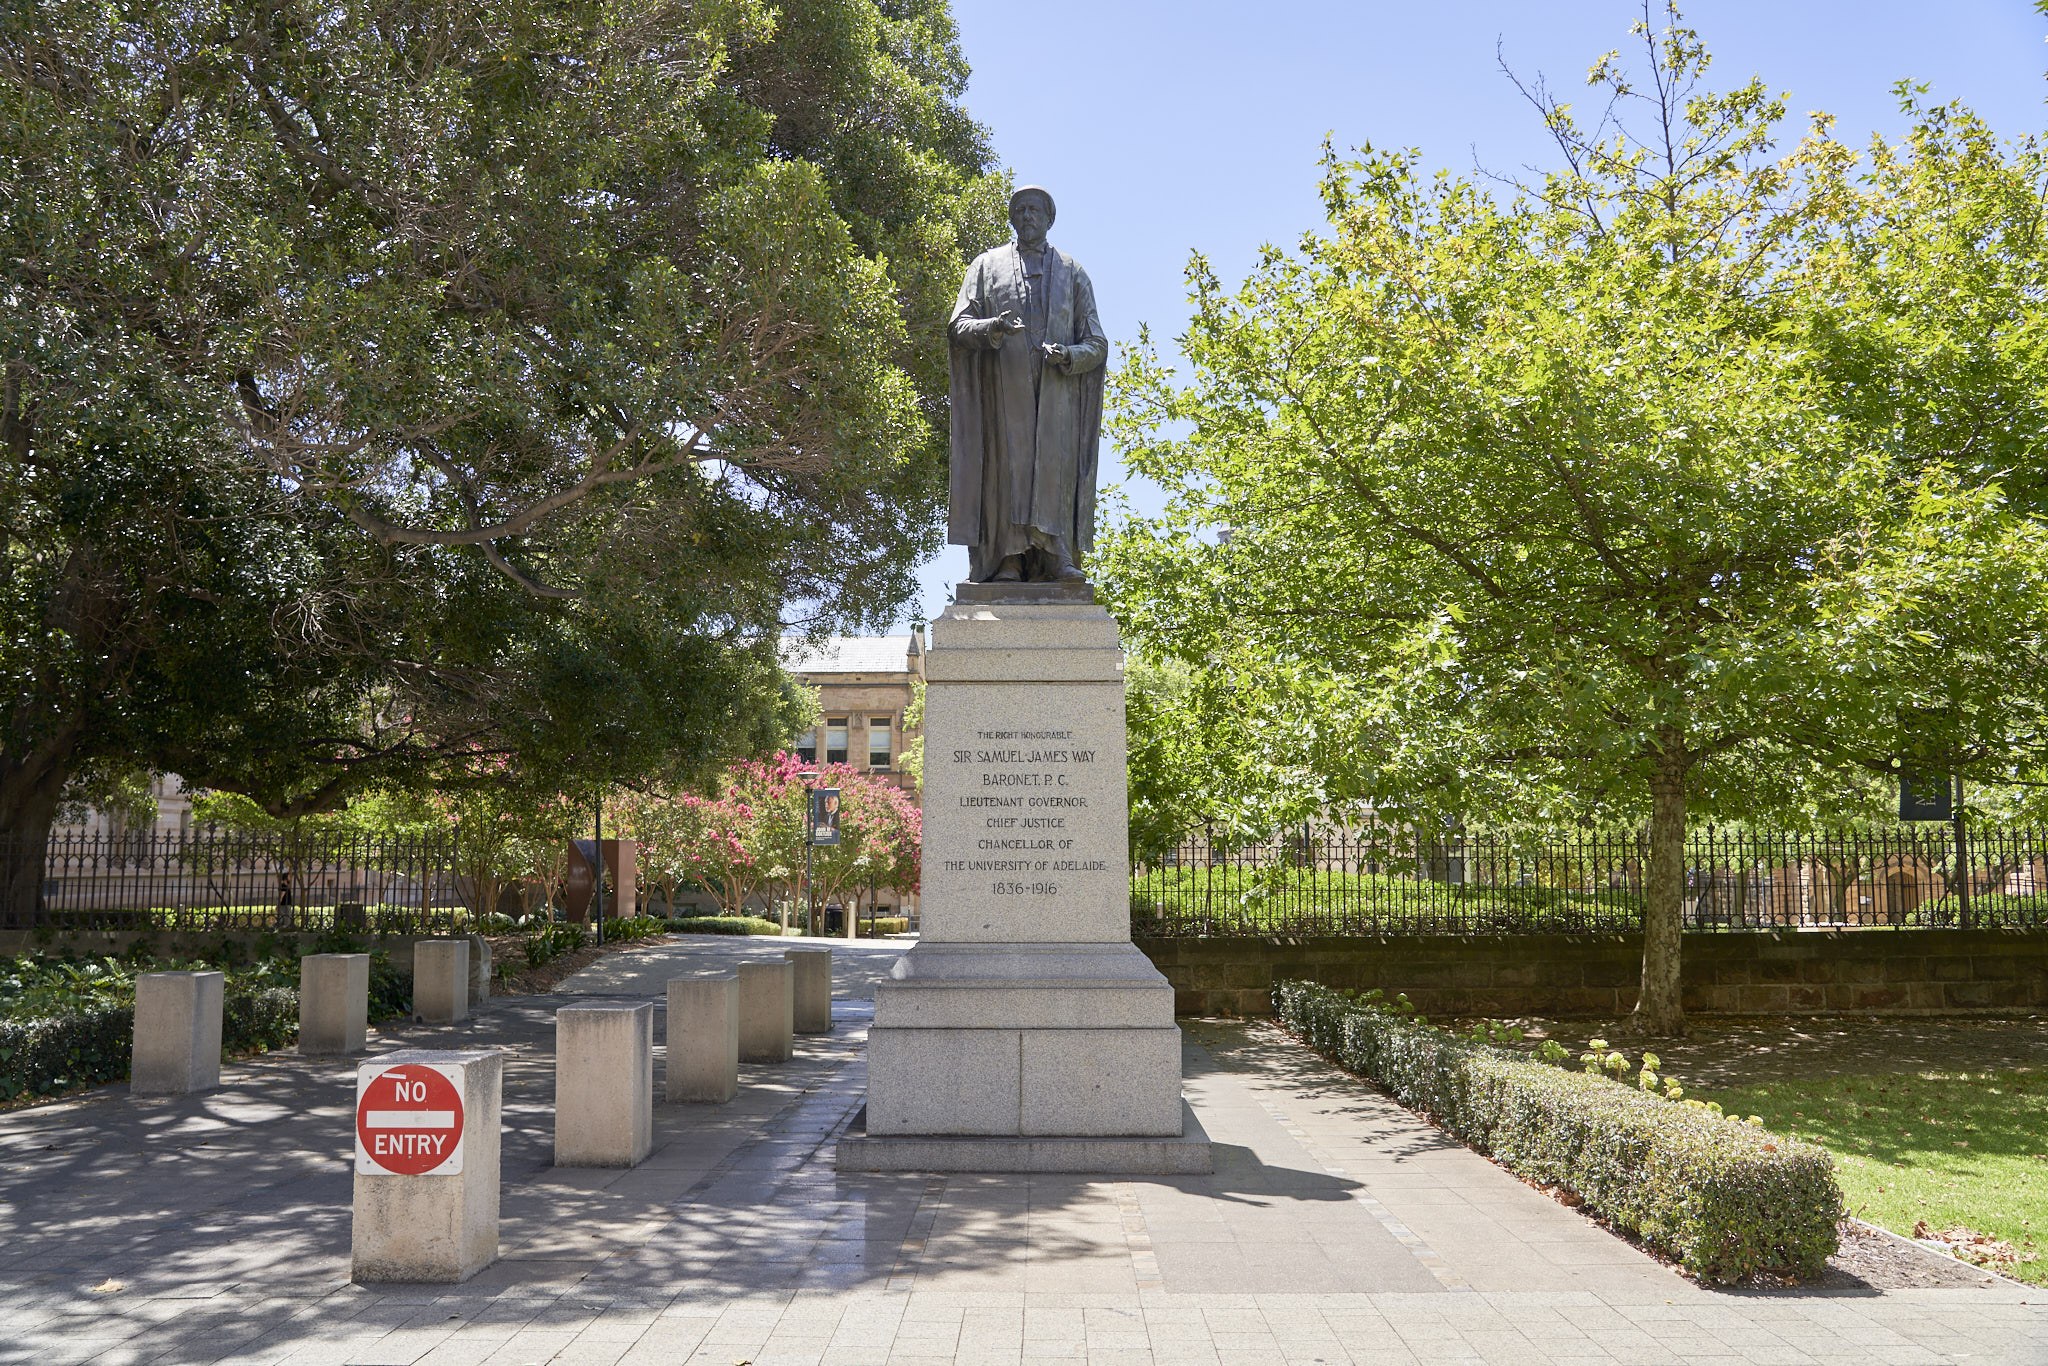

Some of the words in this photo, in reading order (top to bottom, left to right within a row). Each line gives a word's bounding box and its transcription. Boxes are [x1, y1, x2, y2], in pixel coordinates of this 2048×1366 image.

[977, 731, 994, 740] THE
[995, 731, 1018, 740] RIGHT
[1021, 731, 1073, 740] HONOURABLE
[953, 750, 972, 763] SIR
[977, 750, 1025, 763] SAMUEL
[1026, 750, 1068, 763] JAMES
[1072, 750, 1096, 763] WAY
[960, 797, 1024, 808] LIEUTENANT
[1028, 797, 1088, 808] GOVERNOR
[986, 818, 1018, 828] CHIEF
[1020, 818, 1065, 828] JUSTICE
[978, 839, 1055, 850] CHANCELLOR
[1058, 839, 1074, 850] OF
[944, 860, 966, 871] THE
[968, 860, 1032, 871] UNIVERSITY
[1034, 860, 1049, 871] OF
[1053, 860, 1106, 871] ADELAIDE
[992, 881, 1058, 895] 1836-1916
[395, 1081, 427, 1102] NO
[375, 1134, 447, 1155] ENTRY
